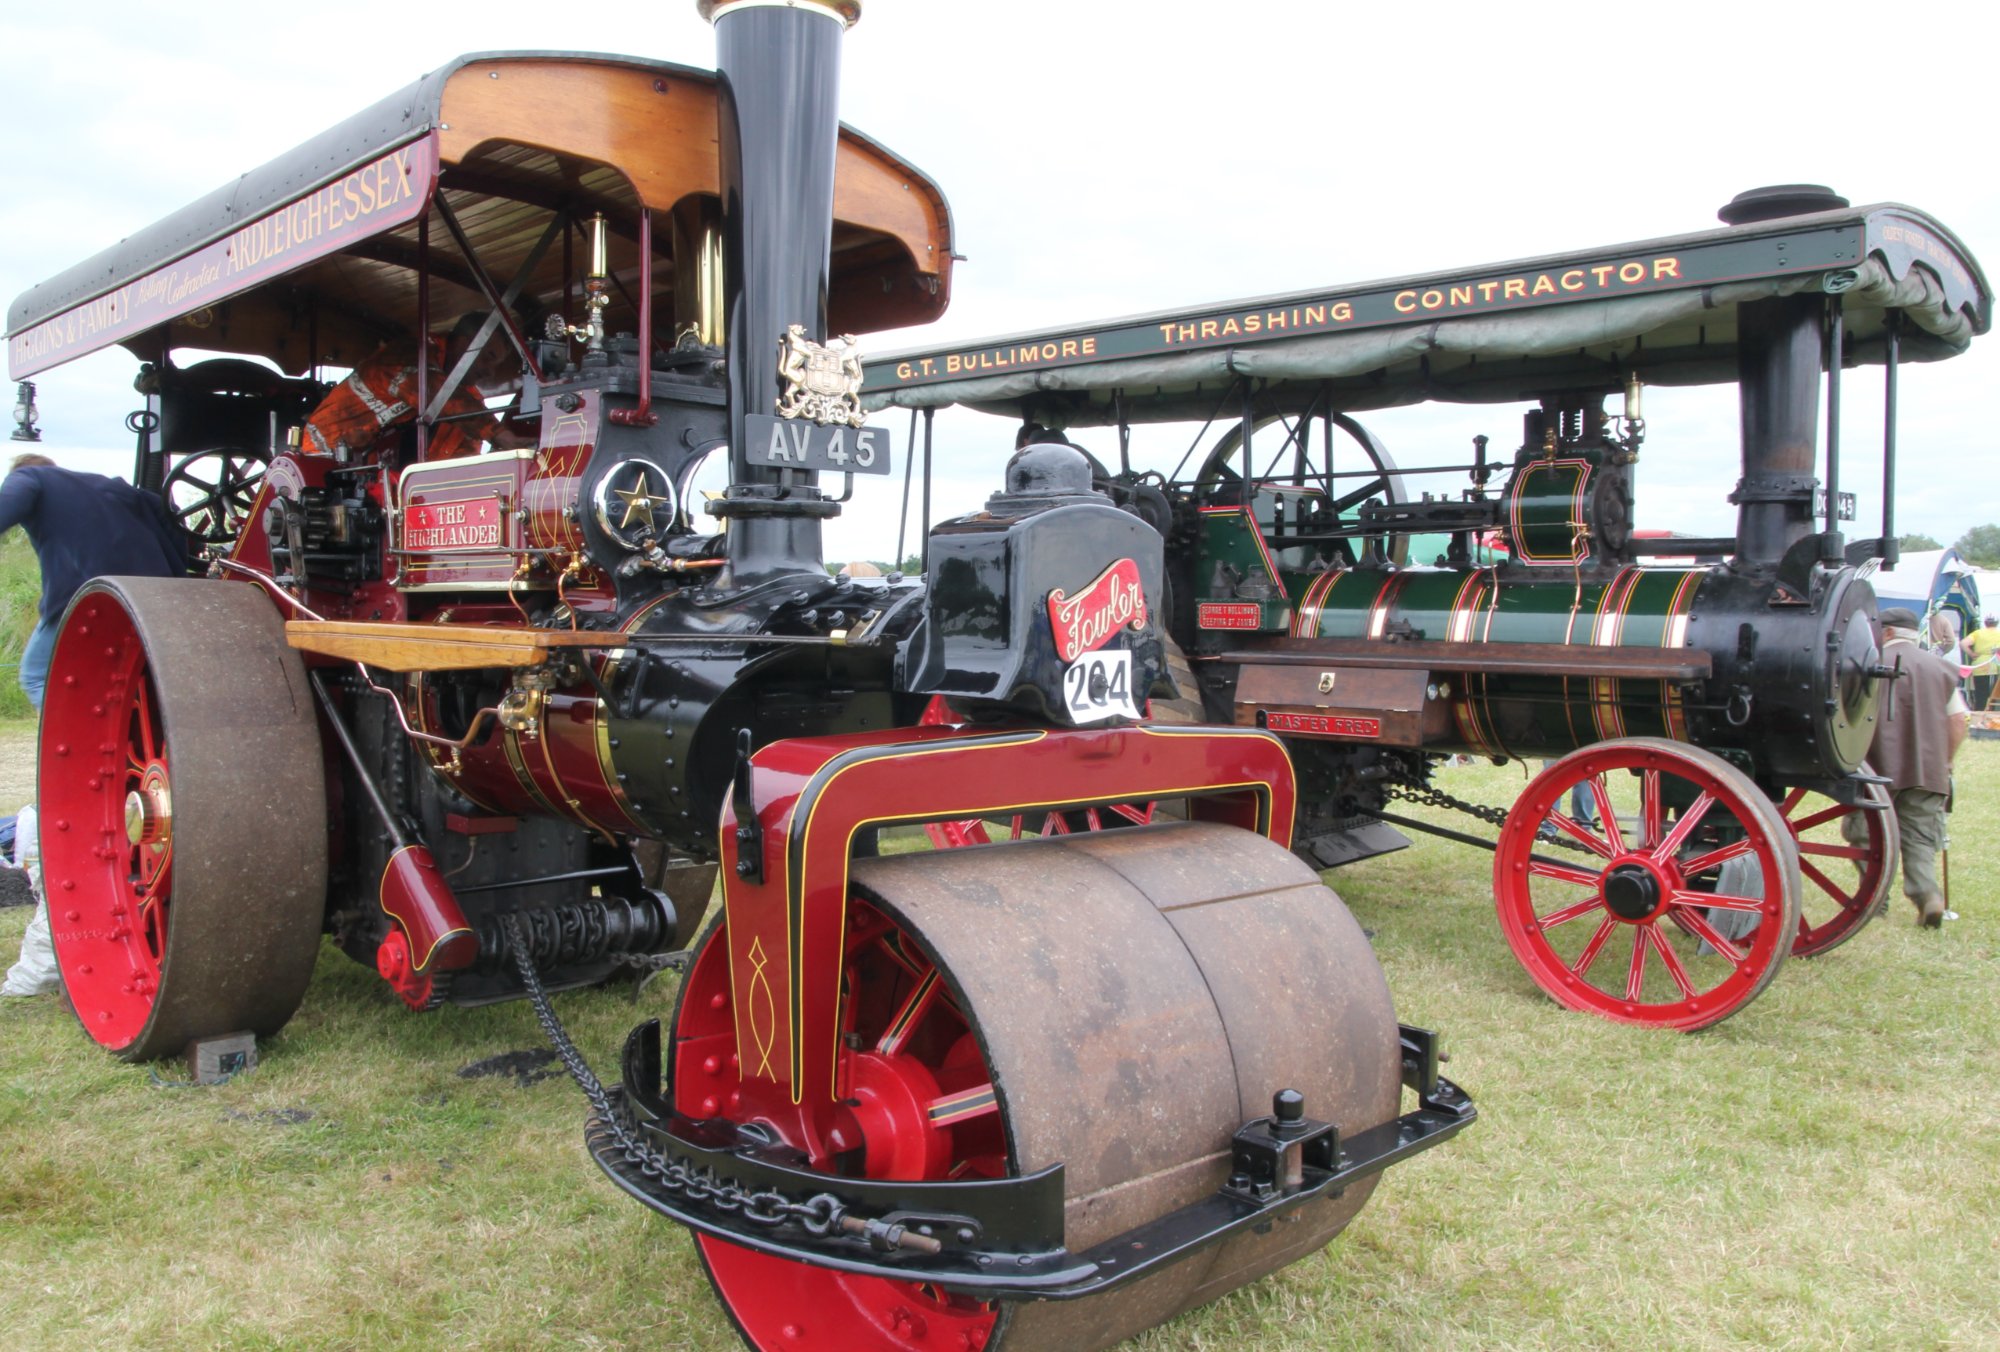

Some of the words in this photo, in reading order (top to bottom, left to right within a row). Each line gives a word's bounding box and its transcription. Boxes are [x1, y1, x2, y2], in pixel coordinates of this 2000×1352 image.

[66, 314, 76, 345] &
[79, 285, 132, 340] FAMILY
[897, 358, 936, 380] G.T.
[947, 338, 1096, 374] BULLIMORE
[1160, 302, 1352, 343] THRASHING
[1394, 257, 1682, 314] CONTRACTOR
[767, 422, 811, 462] AV
[827, 428, 875, 467] 45
[409, 525, 498, 548] HIGHLANDER
[437, 505, 466, 525] THE
[1060, 573, 1143, 660] Fowler
[1068, 660, 1129, 711] 204
[1273, 714, 1328, 731] MASTER
[1335, 718, 1373, 733] FRED
